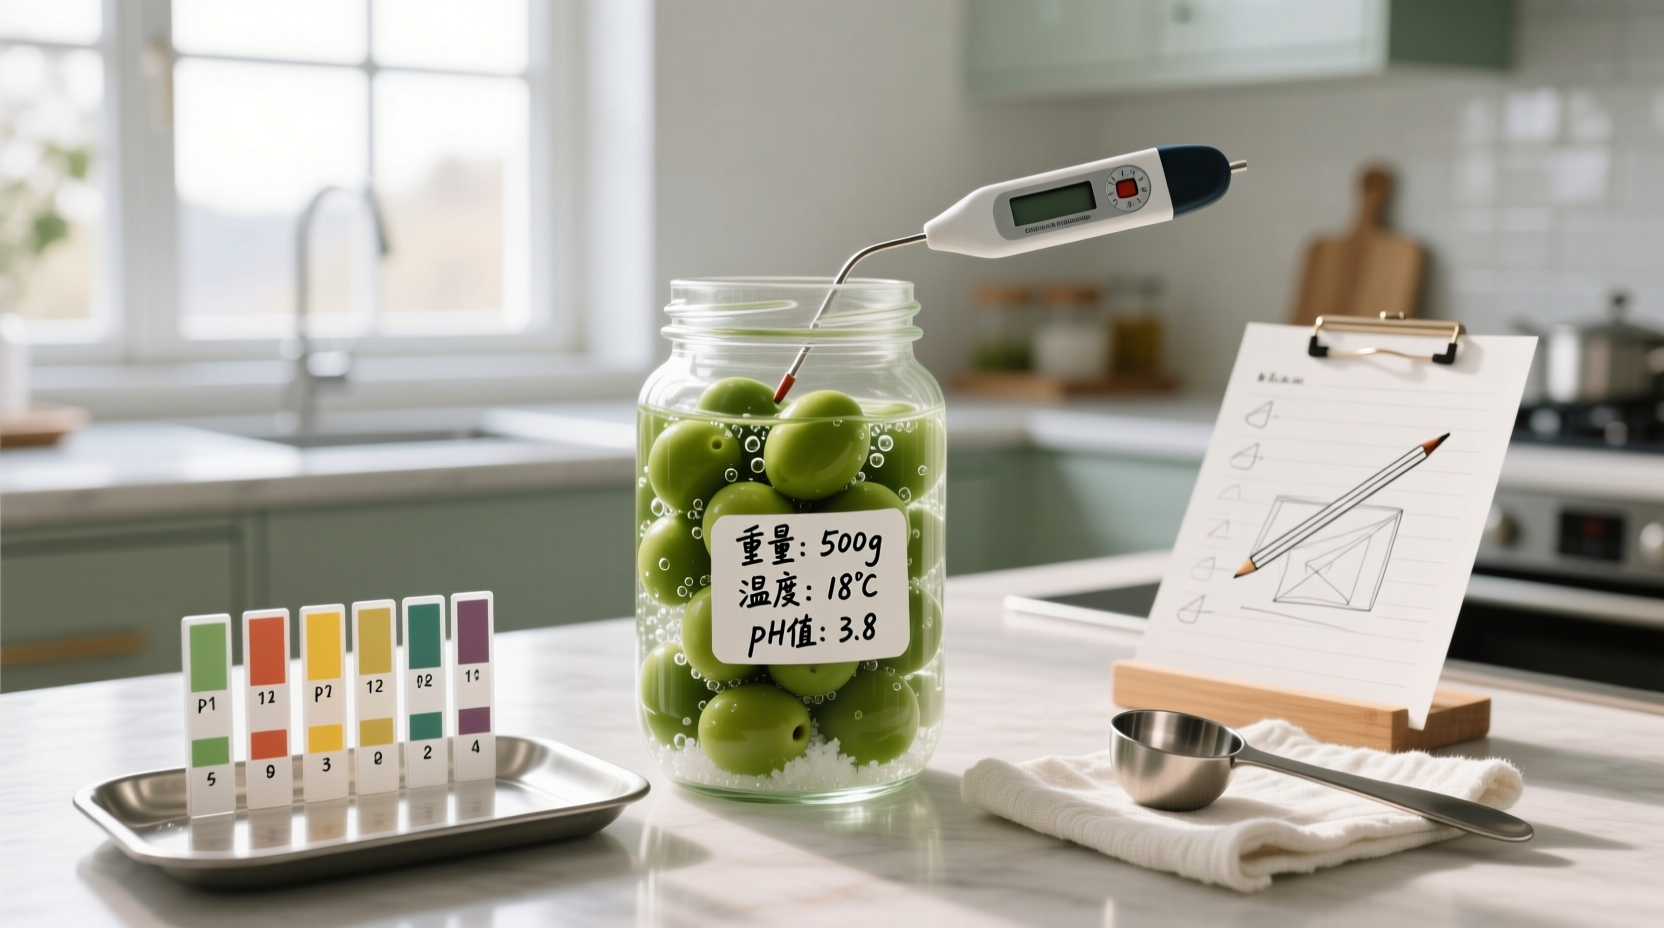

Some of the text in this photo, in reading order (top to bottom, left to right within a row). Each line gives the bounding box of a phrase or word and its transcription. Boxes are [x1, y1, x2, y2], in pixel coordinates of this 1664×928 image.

[820, 529, 882, 567] 500g
[838, 612, 877, 643] 3.8
[366, 679, 384, 694] 12
[258, 690, 276, 705] 12
[423, 745, 432, 760] 2
[322, 757, 332, 772] 3
[206, 771, 216, 787] 5
